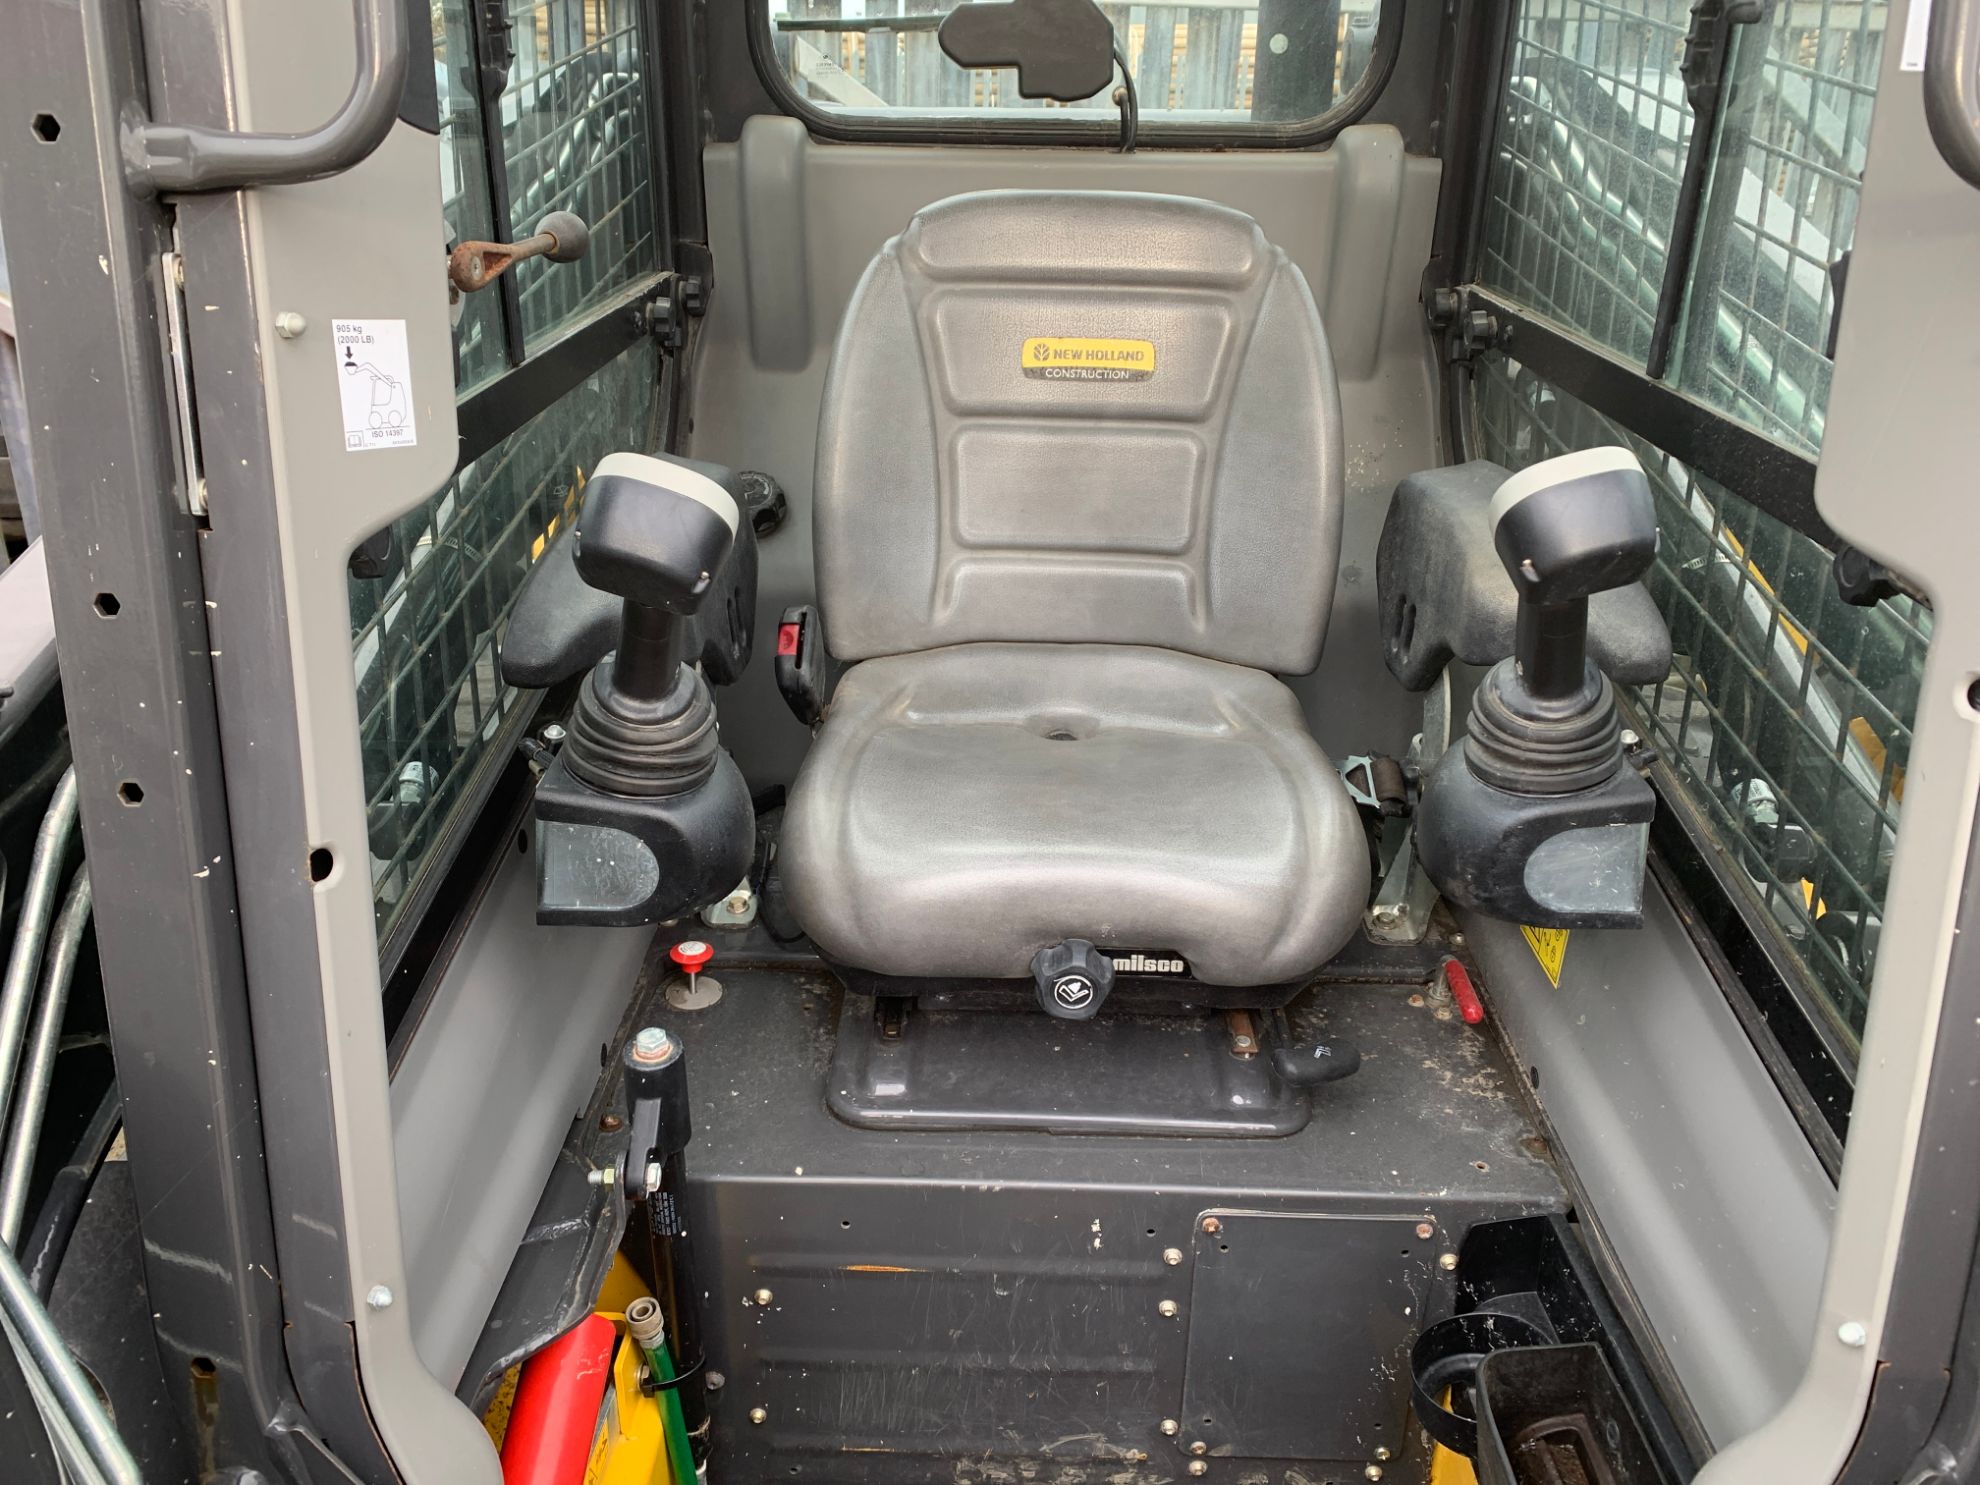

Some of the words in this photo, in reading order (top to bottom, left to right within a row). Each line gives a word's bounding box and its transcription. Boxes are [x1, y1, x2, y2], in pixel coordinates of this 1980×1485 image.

[336, 324, 351, 333] 905
[353, 325, 362, 335] kg
[337, 335, 360, 344] (2000
[361, 335, 375, 344] LB)
[1053, 349, 1083, 360] NEW
[1086, 350, 1144, 361] HOLLAND
[1045, 368, 1130, 380] CONSTRUCTION
[371, 430, 384, 438] ISO
[1112, 954, 1184, 973] milsco
